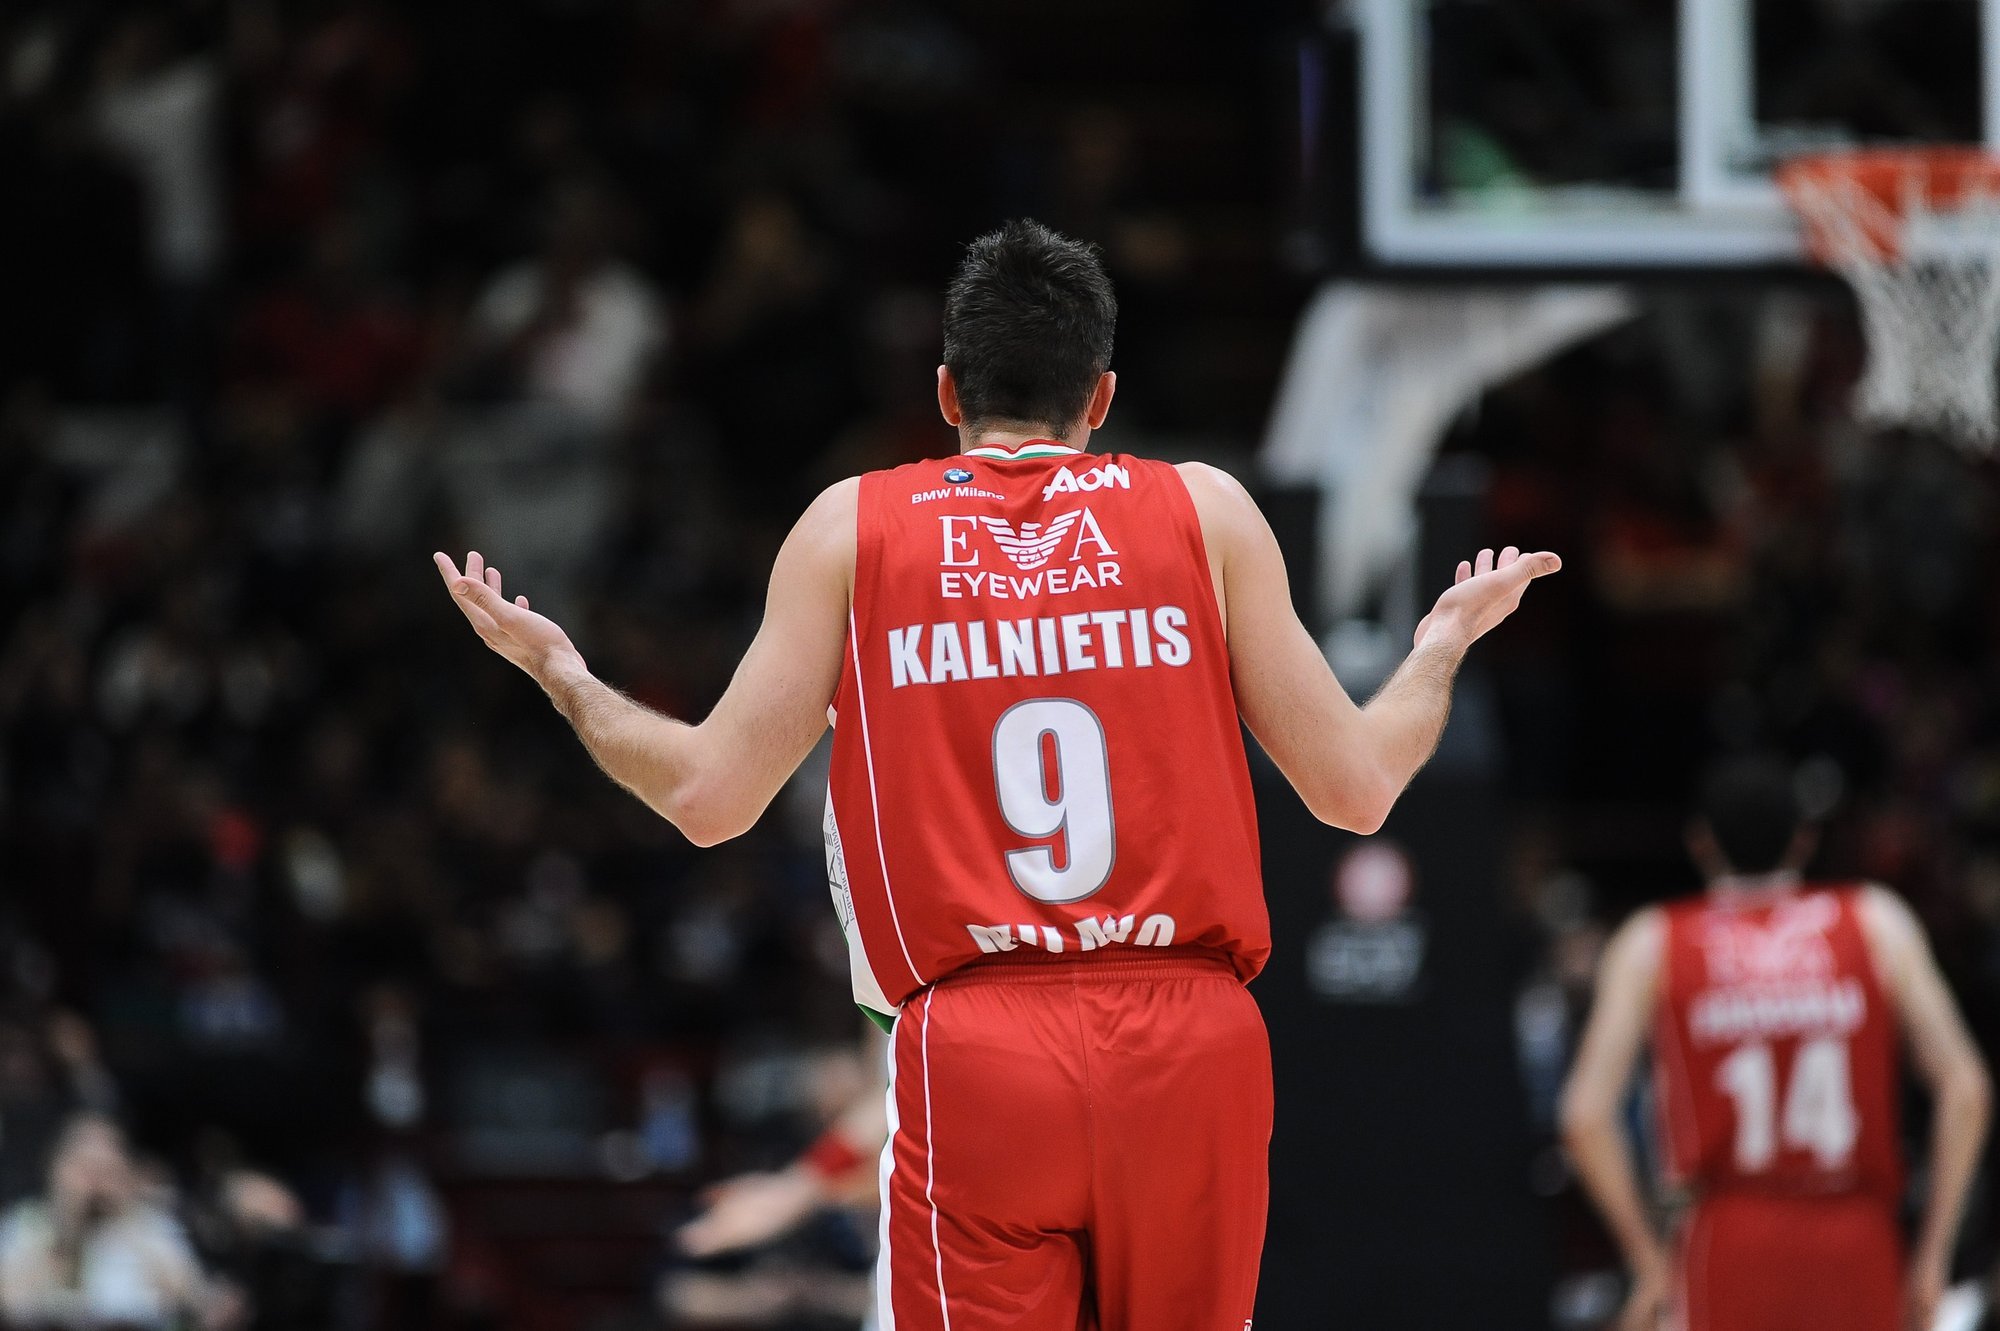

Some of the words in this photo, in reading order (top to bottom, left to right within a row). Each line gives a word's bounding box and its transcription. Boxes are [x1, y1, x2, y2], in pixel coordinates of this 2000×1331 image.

[911, 487, 951, 504] BMW
[955, 486, 1005, 500] Milano
[1042, 464, 1131, 502] AON
[940, 561, 1123, 600] EYEWEAR
[887, 605, 1192, 689] KALNIETIS
[992, 698, 1117, 905] 9
[1712, 1034, 1861, 1174] 14
